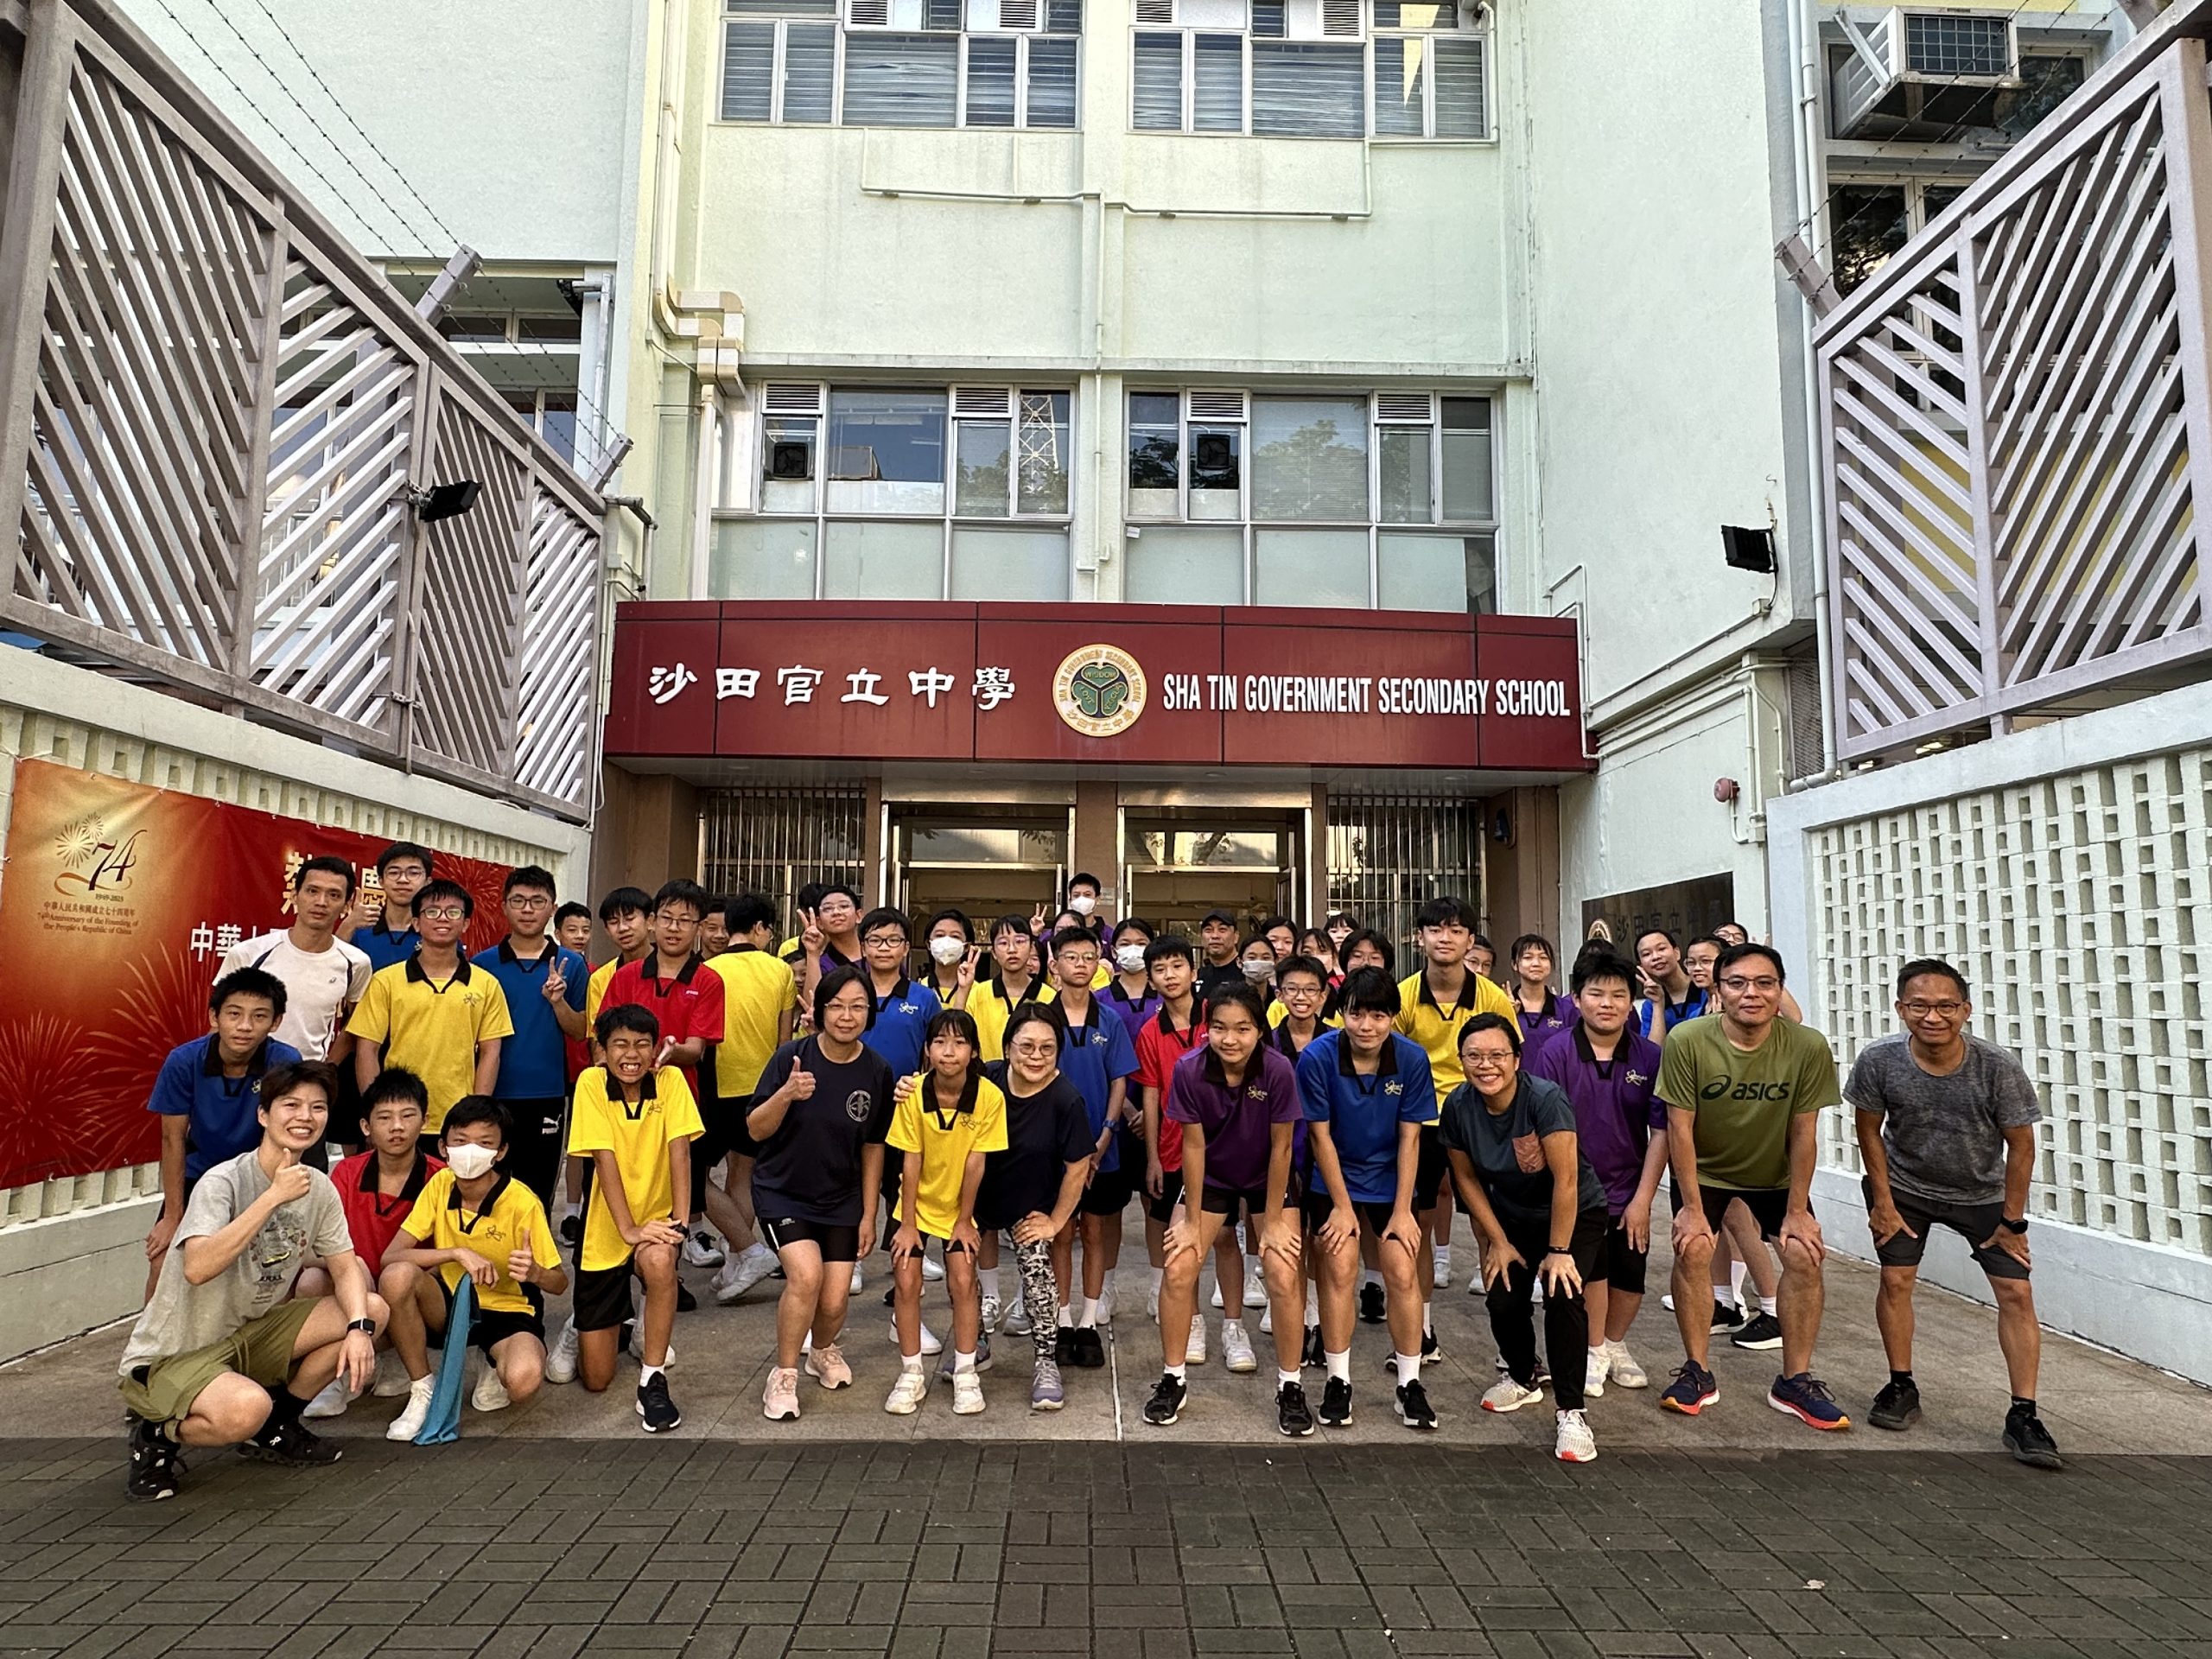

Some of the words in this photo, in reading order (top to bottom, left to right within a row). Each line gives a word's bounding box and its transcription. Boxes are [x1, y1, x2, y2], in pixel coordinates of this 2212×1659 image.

[648, 663, 1015, 710] 沙田官立中學
[1163, 673, 1201, 710] SHA
[1206, 675, 1237, 710] TIN
[1244, 675, 1372, 713] GOVERNMENT
[1378, 677, 1490, 715] SECONDARY
[1495, 678, 1571, 716] SCHOOL
[88, 830, 148, 891] 74
